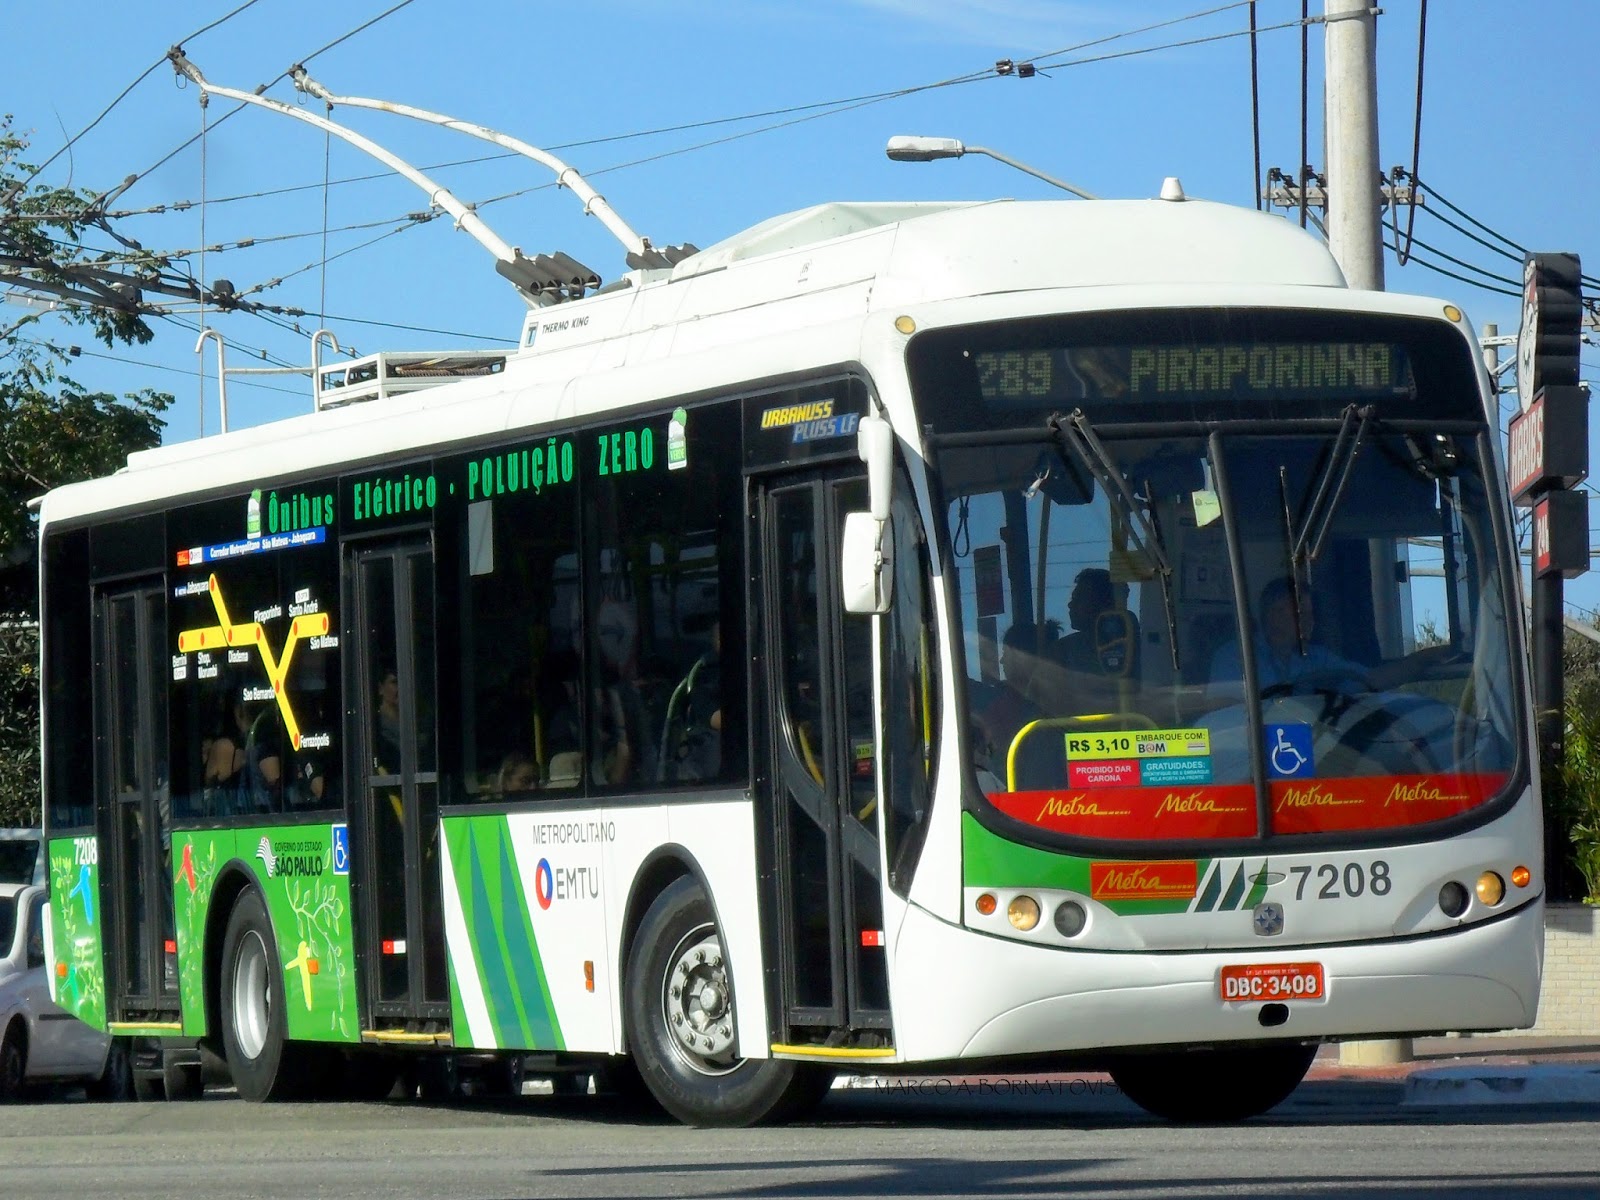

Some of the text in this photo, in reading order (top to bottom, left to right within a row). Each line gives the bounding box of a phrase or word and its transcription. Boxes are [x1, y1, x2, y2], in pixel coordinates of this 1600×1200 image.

[542, 316, 589, 334] THERMO KING
[976, 343, 1390, 395] 289 PIRAPORINHA
[761, 400, 834, 428] URBANUSS
[793, 414, 858, 443] PLUSS LF
[268, 491, 333, 533] Ônibus
[353, 475, 437, 520] Elétrico
[468, 437, 574, 501] POLUIÇÃO
[598, 427, 654, 476] ZERO
[271, 536, 288, 547] Mateus
[291, 531, 316, 544] Jabaquara
[254, 604, 281, 624] Piraporinha
[289, 604, 303, 617] Santo
[320, 635, 338, 648] Mateus
[228, 650, 248, 663] Diadema
[253, 686, 275, 700] Bernardo
[1069, 738, 1130, 754] R$ 3,10
[1135, 732, 1206, 742] EMBARQUE COM:
[1075, 765, 1131, 774] PROIBIDO DAR
[1146, 761, 1206, 771] GRATUIDADES:
[1087, 775, 1121, 783] CARONA
[1155, 791, 1223, 818] Metra
[1276, 784, 1342, 812] Metra
[1384, 779, 1449, 807] Metra
[1036, 793, 1106, 821] Metra
[533, 821, 616, 845] METROPOLITANO
[73, 837, 98, 866] 7208
[275, 841, 322, 852] GOVERNO DO ESTADO
[275, 853, 322, 877] SÃO PAULO
[556, 867, 599, 900] EMTU
[1093, 865, 1168, 896] Metra
[1290, 860, 1392, 901] 7208
